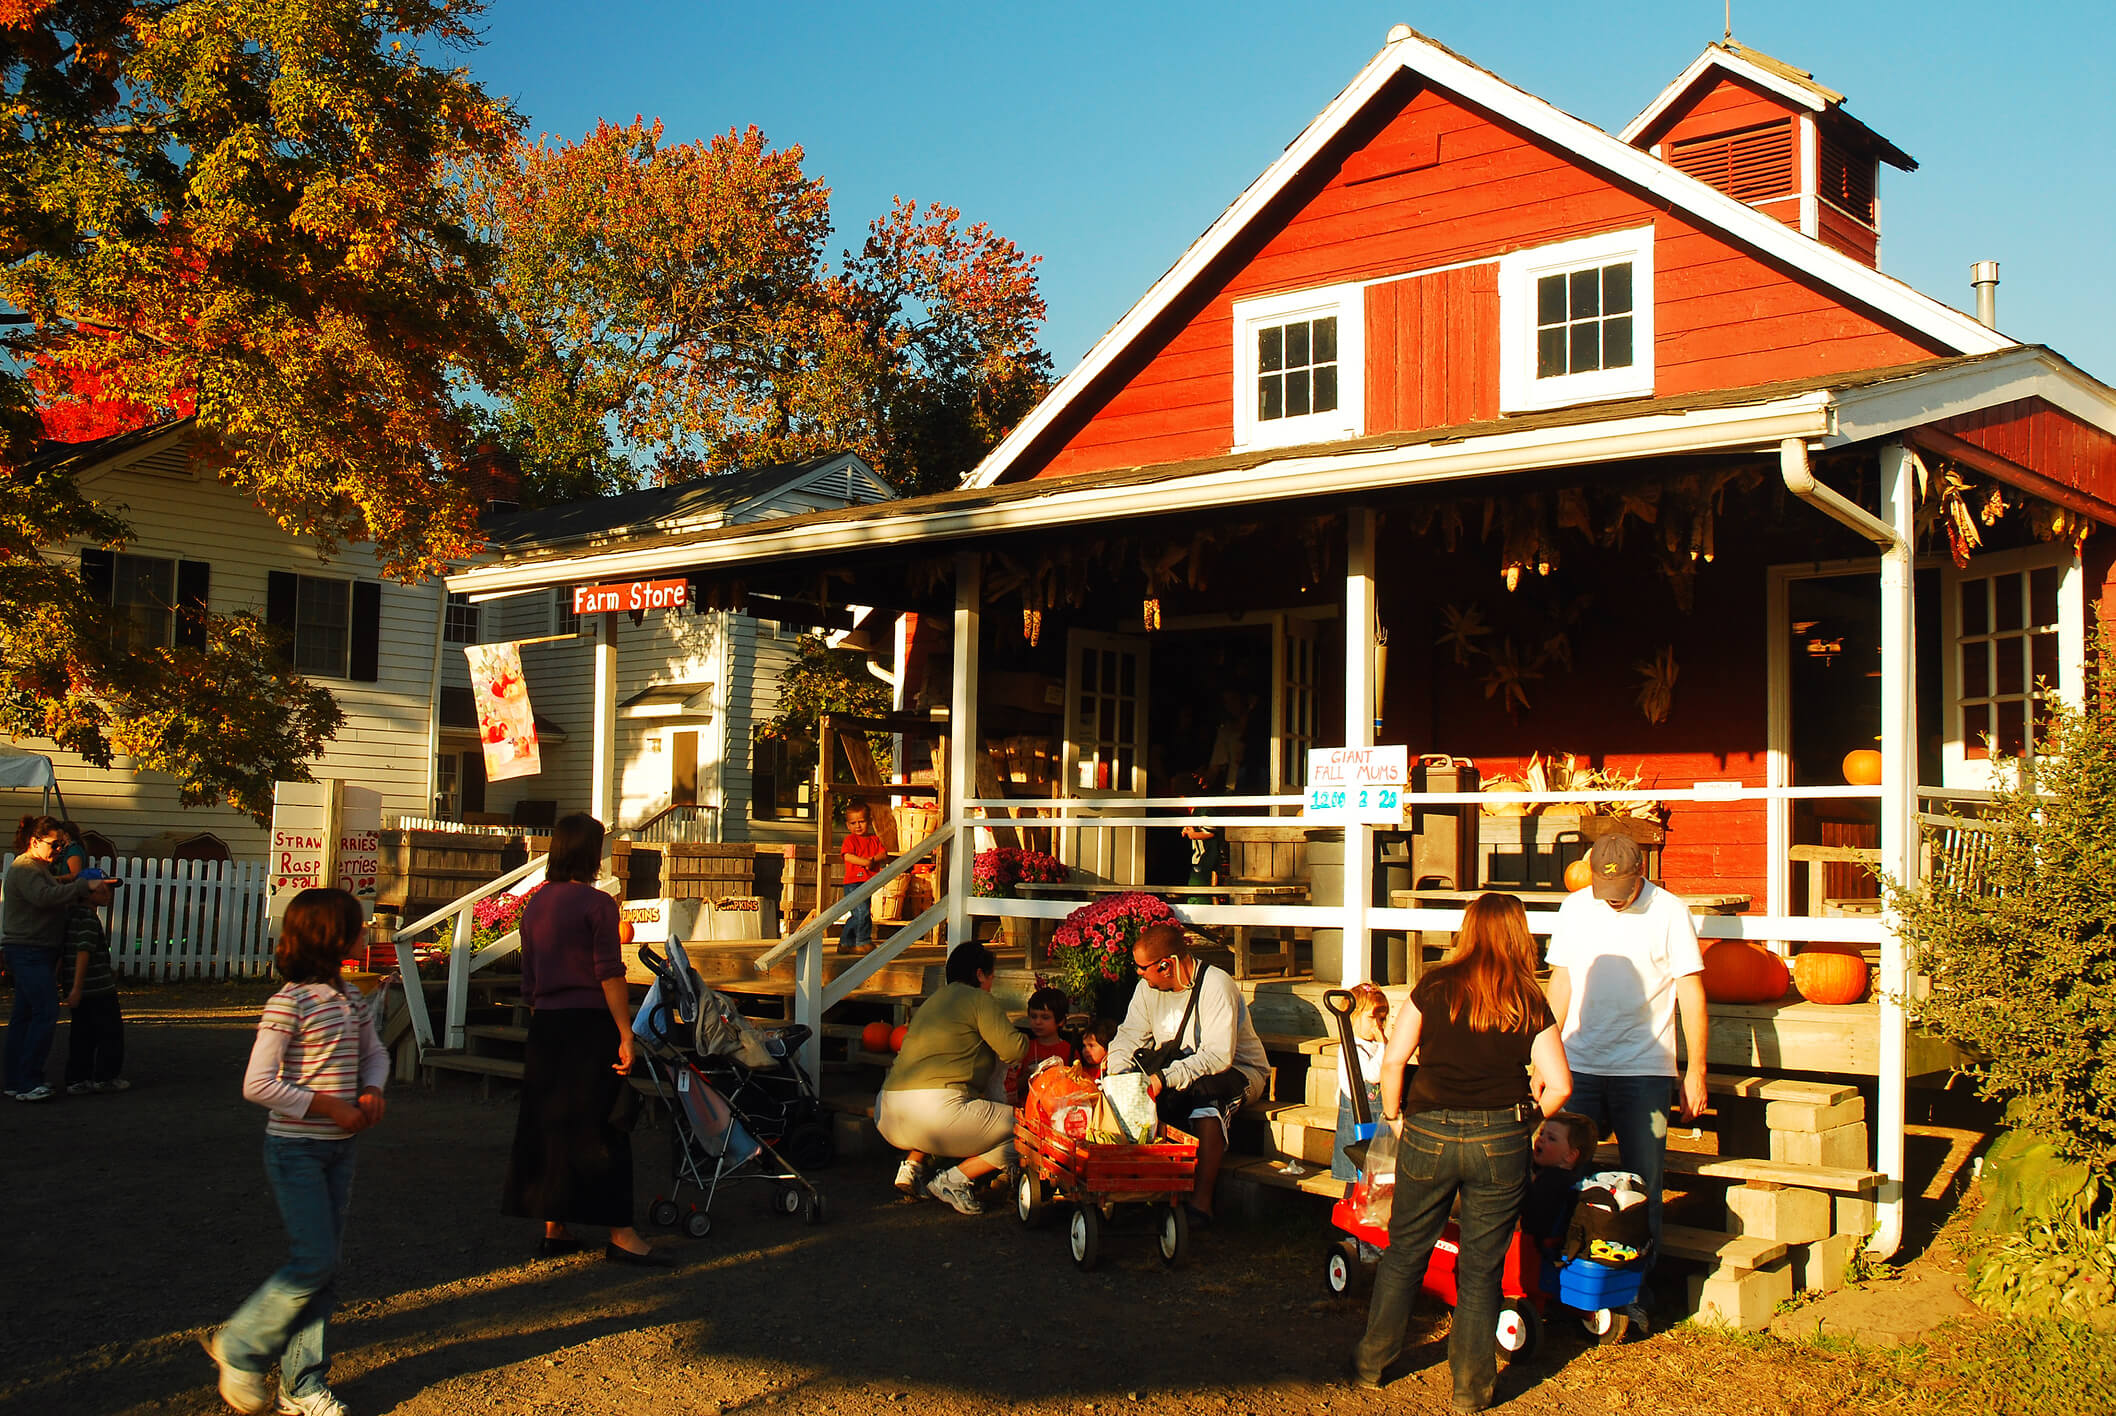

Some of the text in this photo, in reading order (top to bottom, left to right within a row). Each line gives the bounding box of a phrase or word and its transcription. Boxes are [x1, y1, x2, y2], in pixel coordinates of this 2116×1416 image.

[575, 582, 685, 613] Farm Store
[1331, 750, 1374, 764] GIANT
[1314, 765, 1399, 781] FALL MUMS
